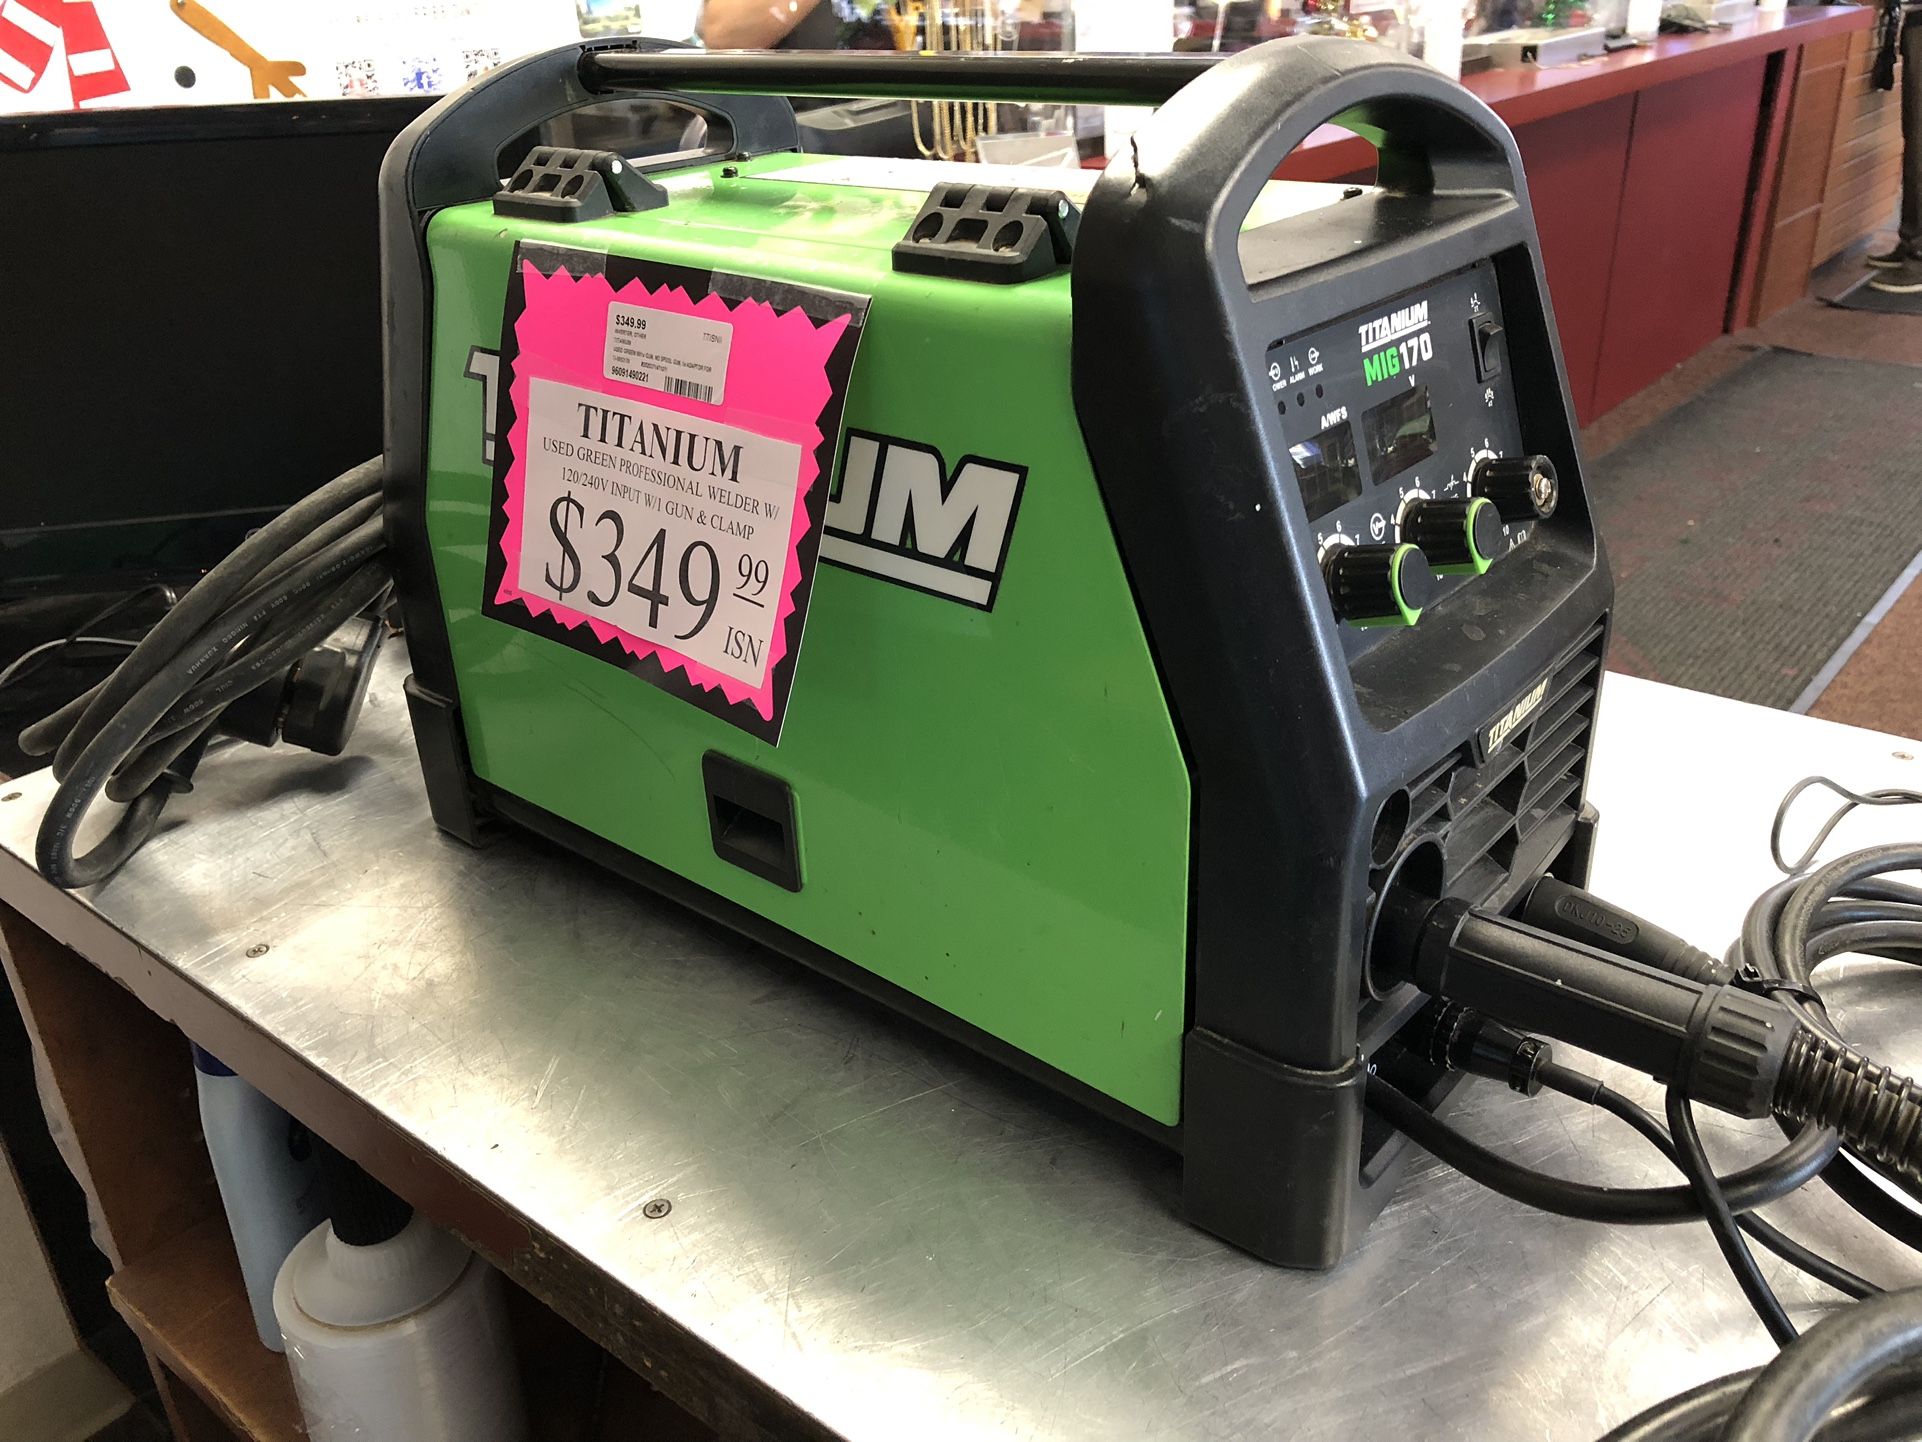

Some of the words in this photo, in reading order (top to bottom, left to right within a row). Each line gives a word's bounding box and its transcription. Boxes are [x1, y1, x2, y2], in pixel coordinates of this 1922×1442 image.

[616, 315, 646, 330] $349.99
[1358, 300, 1430, 350] TITANIUM
[1307, 363, 1324, 377] WORK
[1289, 371, 1306, 385] ALARM
[1408, 374, 1415, 387] V
[1320, 406, 1348, 430] A/WFS
[577, 402, 744, 484] TITANIUM
[1484, 437, 1489, 449] 6
[1470, 447, 1475, 458] 5
[543, 436, 575, 458] USED
[576, 446, 618, 470] GREEN
[619, 458, 703, 497] PROFESSIONAL
[707, 484, 760, 515] WELDER
[764, 502, 780, 520] W/
[1414, 476, 1420, 488] 6
[1398, 487, 1405, 499] 5
[561, 466, 609, 492] 120/240V
[611, 480, 642, 504] INPUT
[644, 492, 662, 513] W/1
[665, 499, 695, 524] GUN
[696, 509, 707, 526] &
[710, 513, 754, 541] CLAMP
[1336, 520, 1342, 532] 6
[1502, 524, 1510, 537] 10
[1317, 532, 1324, 544] 5
[545, 490, 721, 641] $349
[735, 553, 770, 597] 99
[722, 625, 765, 668] ISN
[1488, 677, 1549, 753] TITANIUM
